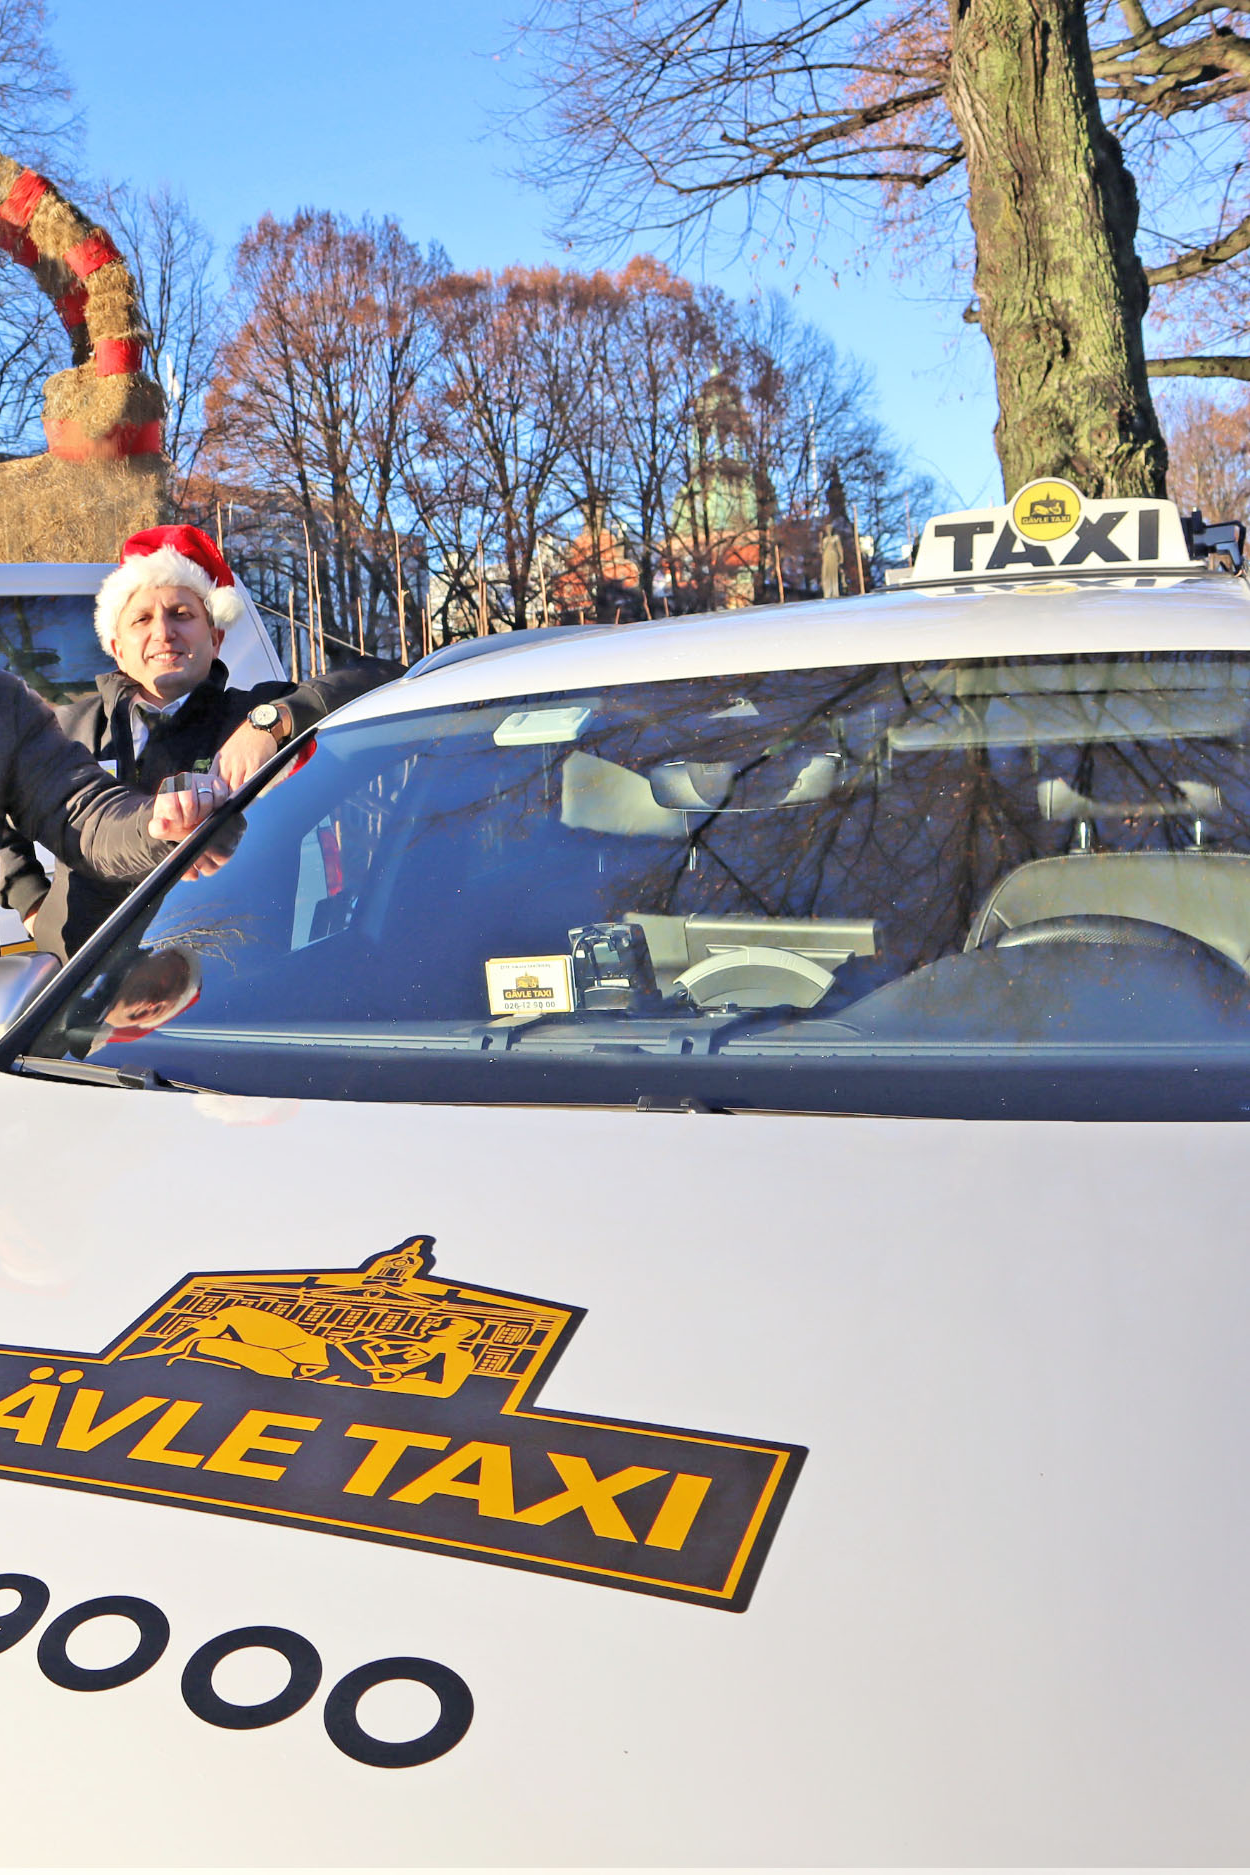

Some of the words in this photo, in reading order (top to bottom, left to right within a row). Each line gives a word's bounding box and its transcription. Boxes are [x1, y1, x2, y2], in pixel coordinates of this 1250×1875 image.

[935, 509, 1159, 572] TAXI
[505, 989, 532, 999] GÄVLE
[533, 989, 552, 998] TAXI
[342, 1424, 713, 1552] TAXI
